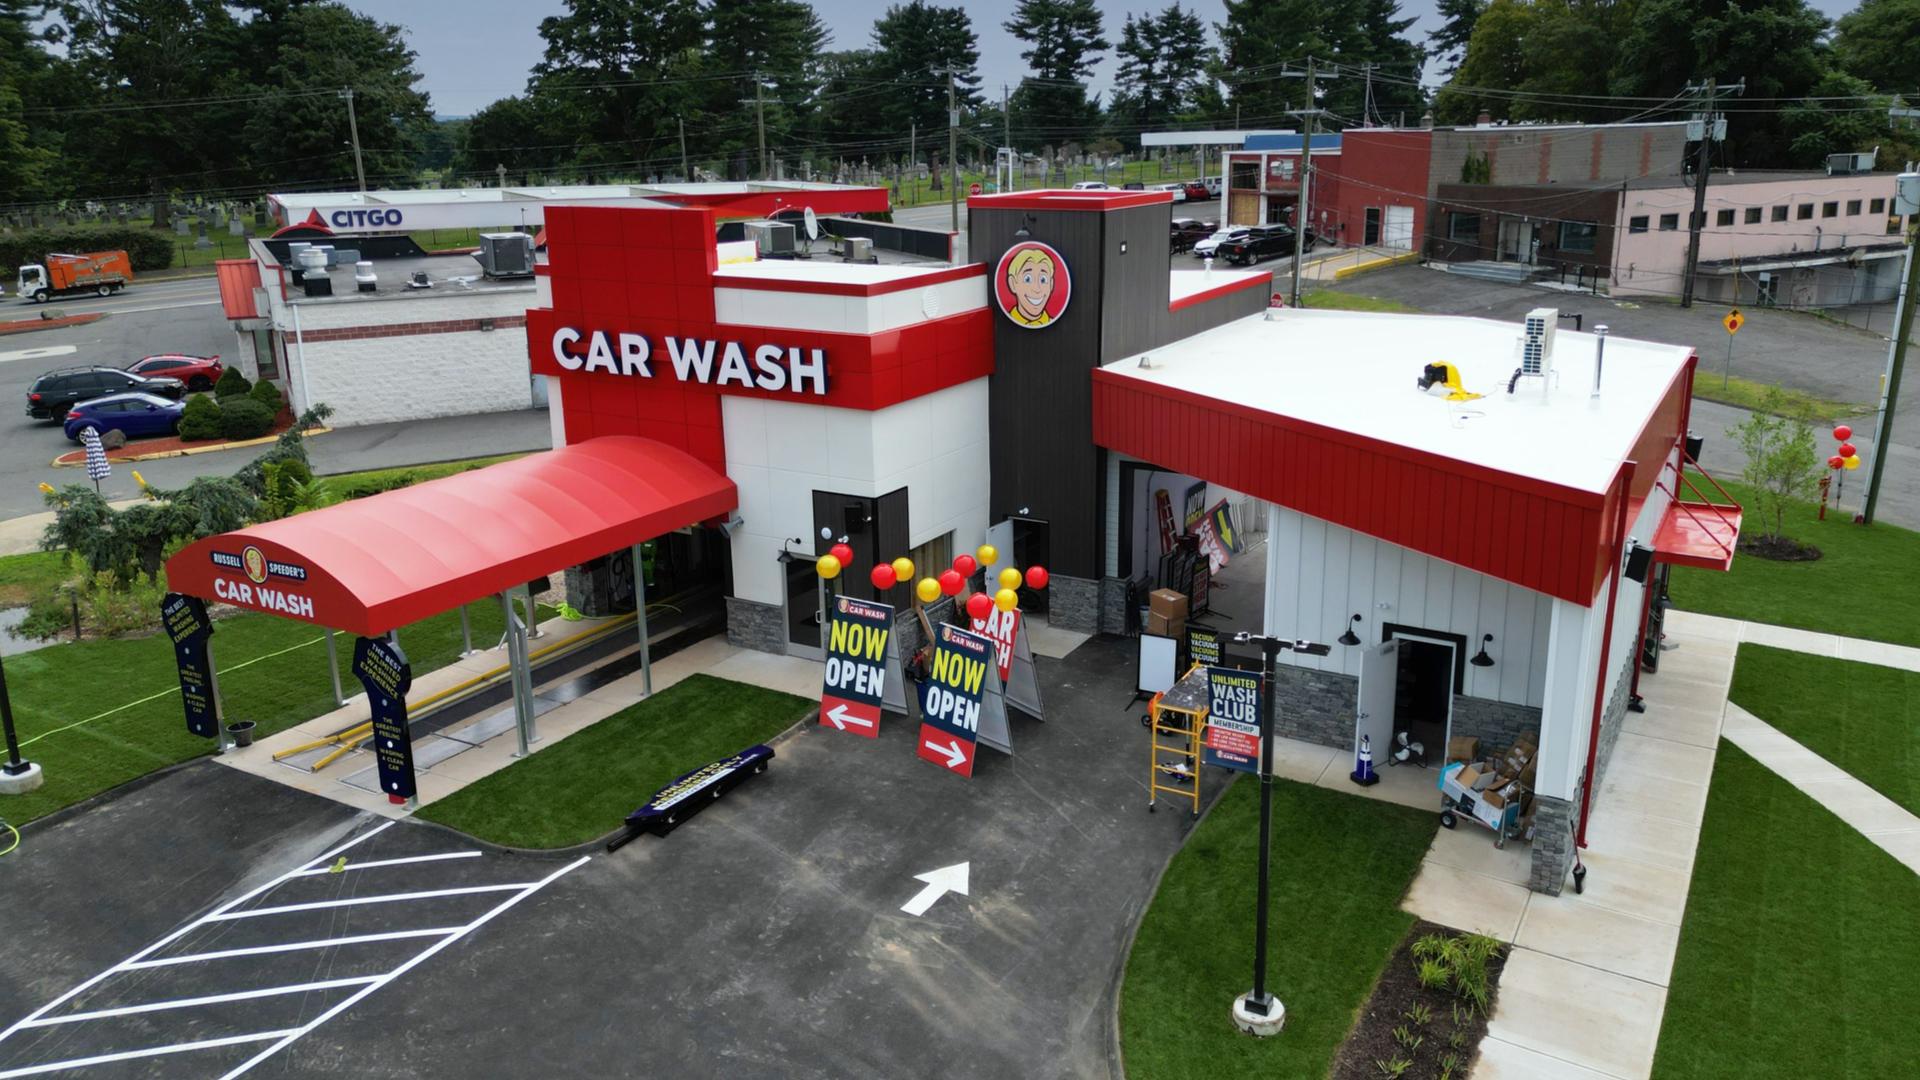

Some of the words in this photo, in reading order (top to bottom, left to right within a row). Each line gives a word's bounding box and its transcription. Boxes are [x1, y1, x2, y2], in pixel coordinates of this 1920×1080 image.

[332, 208, 403, 228] CITGO
[552, 327, 653, 378] CAR
[664, 336, 826, 395] WASH
[213, 552, 241, 567] RUSSELL
[268, 562, 305, 579] SPEEDER'S
[164, 606, 175, 616] THE
[173, 598, 185, 612] BEST
[214, 578, 253, 605] CAR
[255, 587, 314, 618] WASH
[167, 605, 192, 626] UNLIMITED
[172, 614, 195, 633] WASHING
[849, 606, 864, 615] CAR
[864, 609, 886, 620] WASH
[174, 621, 201, 643] EXPERIENCE
[829, 619, 888, 662] NOW
[951, 635, 965, 646] CAR
[965, 639, 985, 652] WASH
[1191, 640, 1219, 650] VACUUMS
[1191, 646, 1219, 656] VACUUMS
[367, 648, 401, 682] UNLIMITED
[371, 643, 384, 658] THE
[385, 655, 402, 672] BEST
[1191, 653, 1219, 663] VACUUMS
[359, 661, 399, 700] EXPERIENCE
[366, 657, 397, 688] WASHING
[825, 657, 885, 698] OPEN
[932, 646, 986, 695] NOW
[1211, 673, 1257, 689] UNLIMITED
[1212, 683, 1256, 705] WASH
[926, 685, 981, 733] OPEN
[1212, 698, 1256, 723] CLUB
[1213, 718, 1255, 733] MEMBERSHIP
[710, 755, 742, 775] ONLY
[655, 762, 720, 798] UNLIMITED
